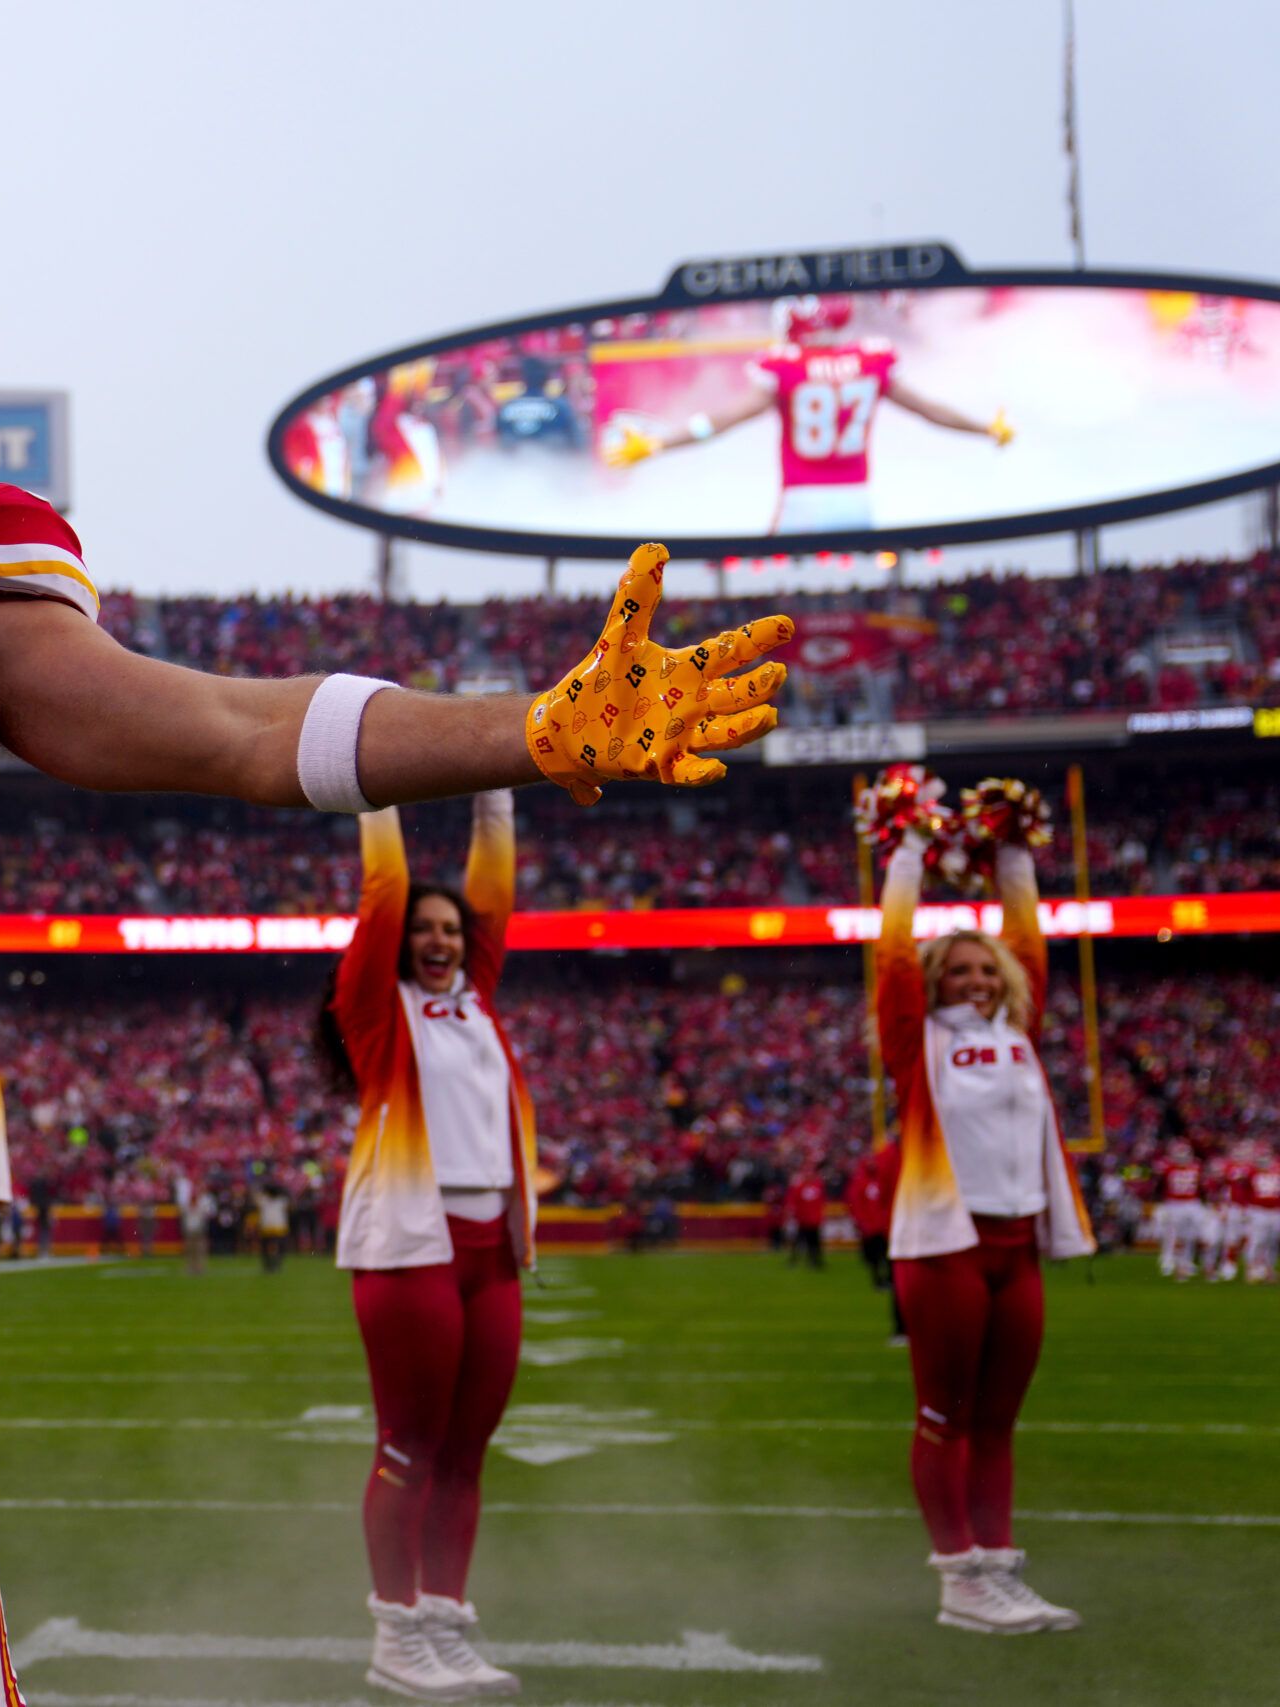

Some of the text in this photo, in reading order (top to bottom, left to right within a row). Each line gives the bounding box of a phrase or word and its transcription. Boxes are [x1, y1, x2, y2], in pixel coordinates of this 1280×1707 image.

[682, 247, 945, 297] GEHA FIELD
[793, 374, 878, 459] 87
[619, 598, 640, 623] 87
[689, 646, 710, 671] 87
[624, 664, 647, 689] 87
[566, 678, 583, 703] 87
[662, 687, 684, 710] 87
[599, 703, 620, 728] 87
[535, 736, 554, 755] 87
[637, 728, 655, 752] 87
[580, 744, 597, 768] 87
